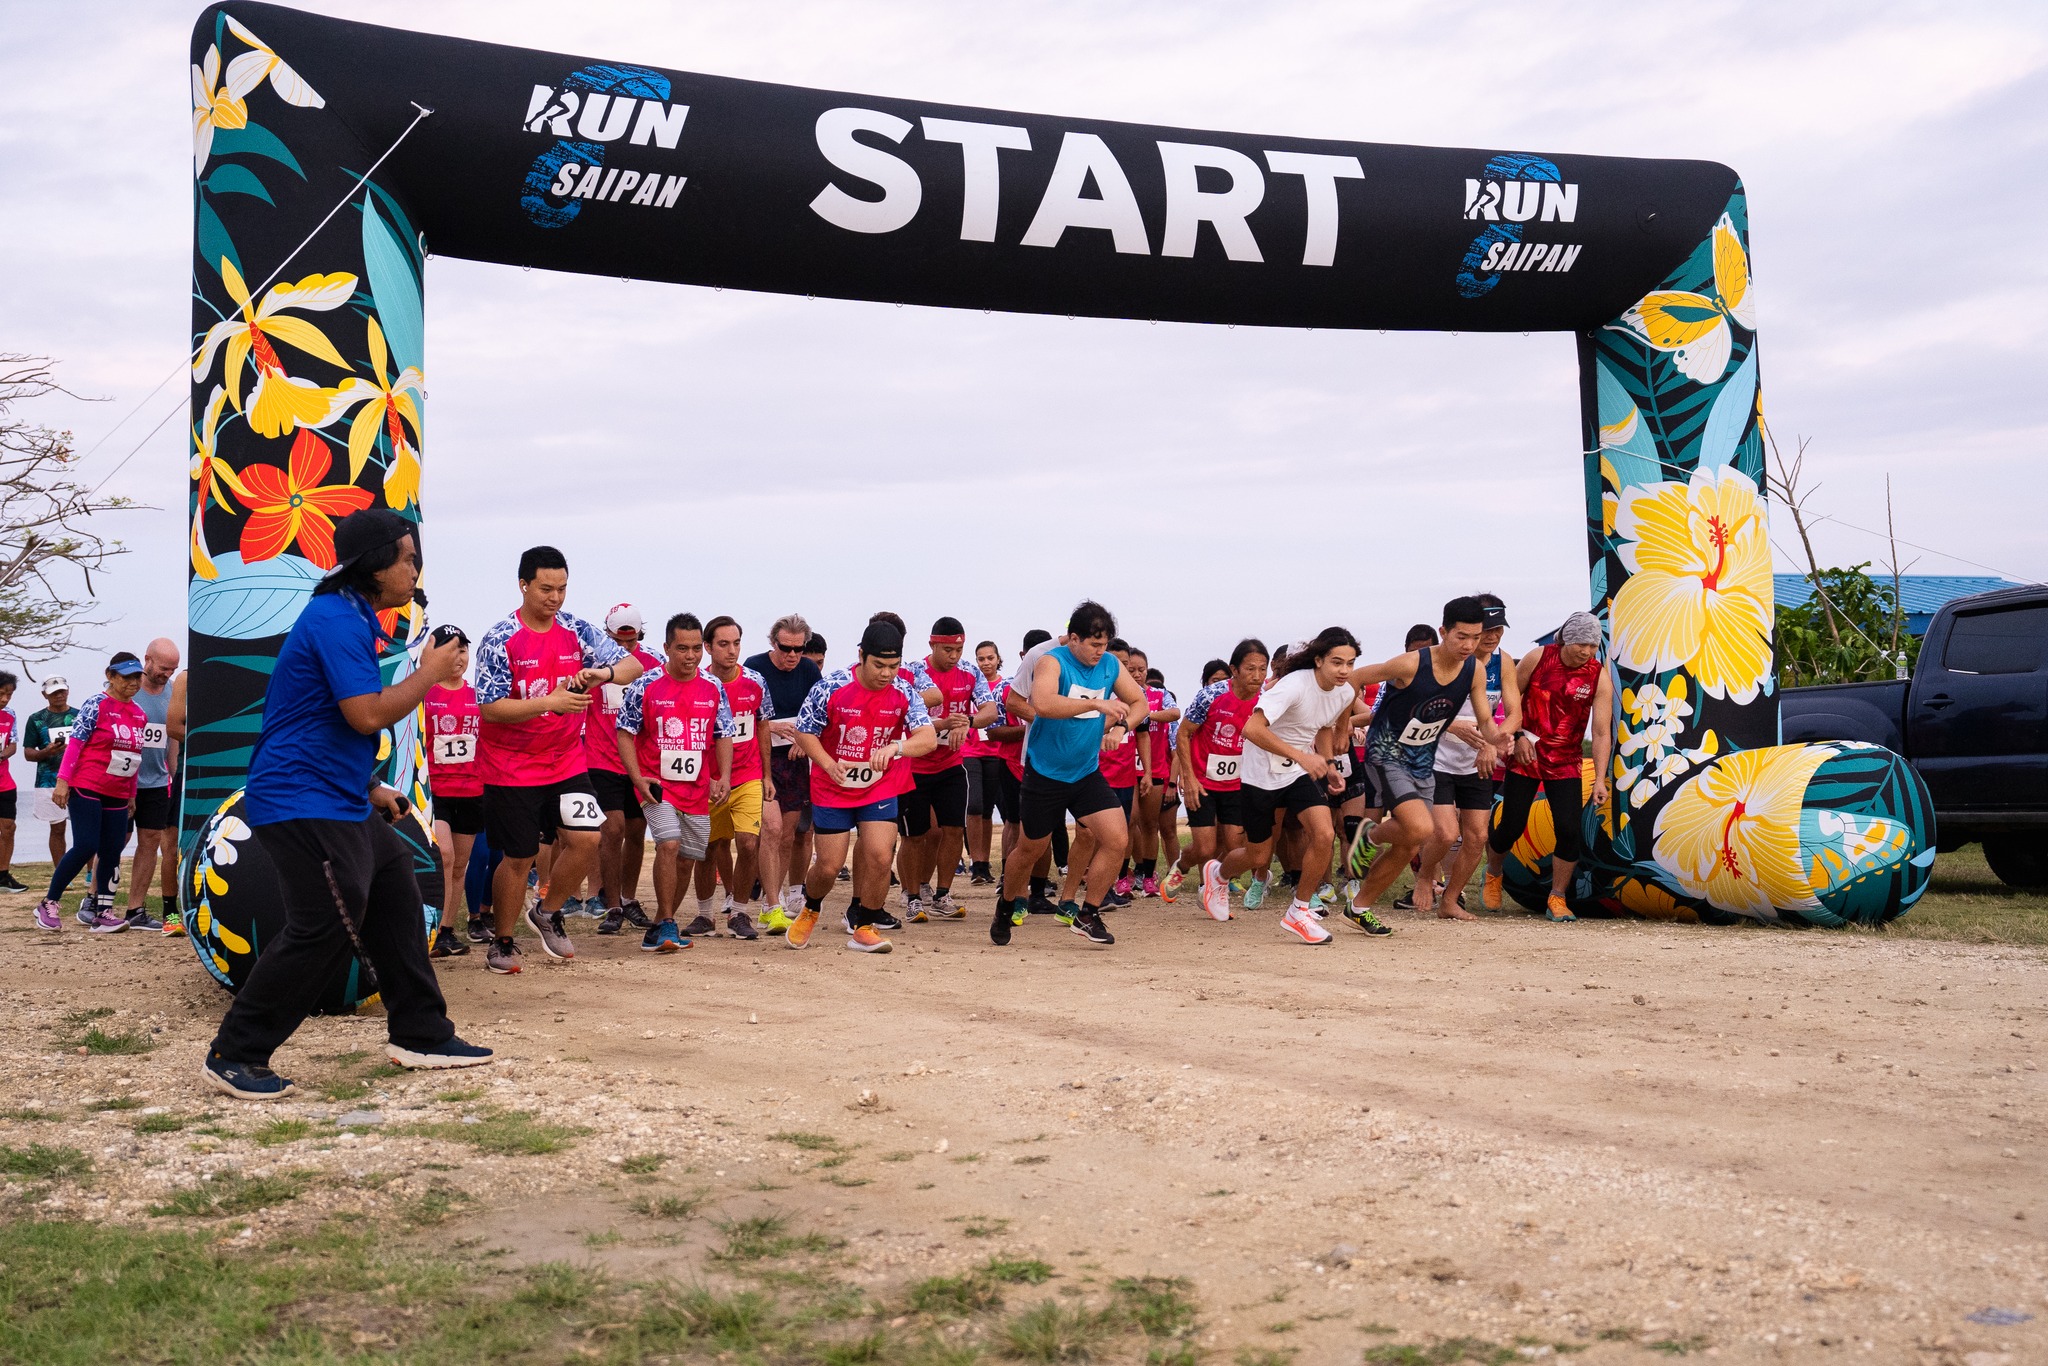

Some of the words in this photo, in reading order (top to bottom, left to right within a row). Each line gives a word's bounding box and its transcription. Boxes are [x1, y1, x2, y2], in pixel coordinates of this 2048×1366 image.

[522, 84, 690, 149] RUN
[551, 162, 688, 209] SAIPAN
[809, 107, 1365, 267] START
[1463, 178, 1579, 222] RUN
[1480, 242, 1583, 273] SAIPAN
[949, 701, 968, 713] 5K
[463, 715, 480, 728] 5K
[690, 718, 710, 733] 5K
[144, 728, 163, 743] 99
[691, 733, 706, 742] FUN
[873, 726, 895, 739] 5K
[1406, 725, 1440, 741] 102
[444, 739, 468, 758] 13
[691, 742, 706, 750] RUN
[836, 749, 864, 759] SERVICE
[122, 757, 132, 772] 3
[671, 757, 695, 775] 46
[1216, 761, 1237, 775] 80
[846, 767, 873, 783] 40
[572, 800, 598, 819] 28
